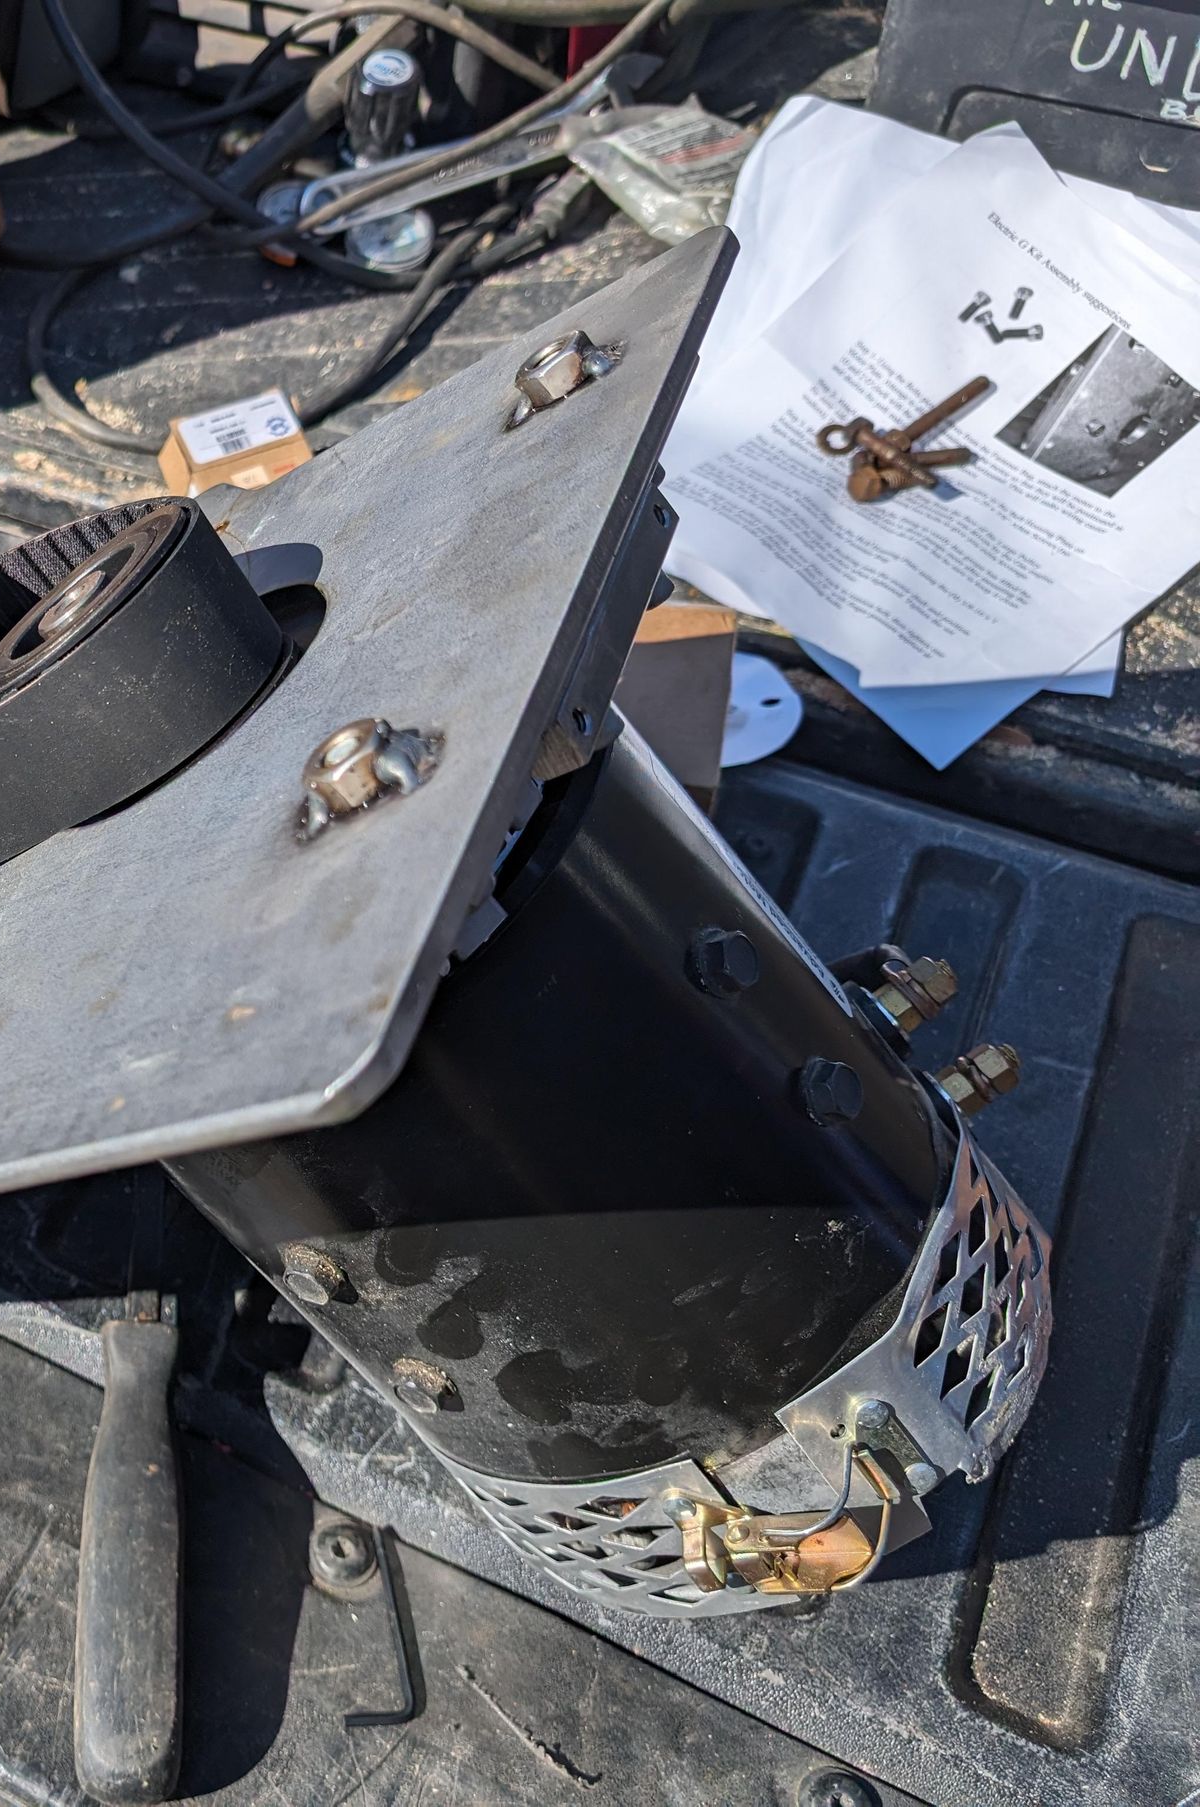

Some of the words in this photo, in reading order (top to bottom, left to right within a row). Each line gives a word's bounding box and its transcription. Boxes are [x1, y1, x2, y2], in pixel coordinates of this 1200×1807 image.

[987, 212, 1021, 241] Electric
[1026, 244, 1044, 262] Kit
[1042, 257, 1084, 295] Assembly
[1082, 287, 1132, 331] suggestions
